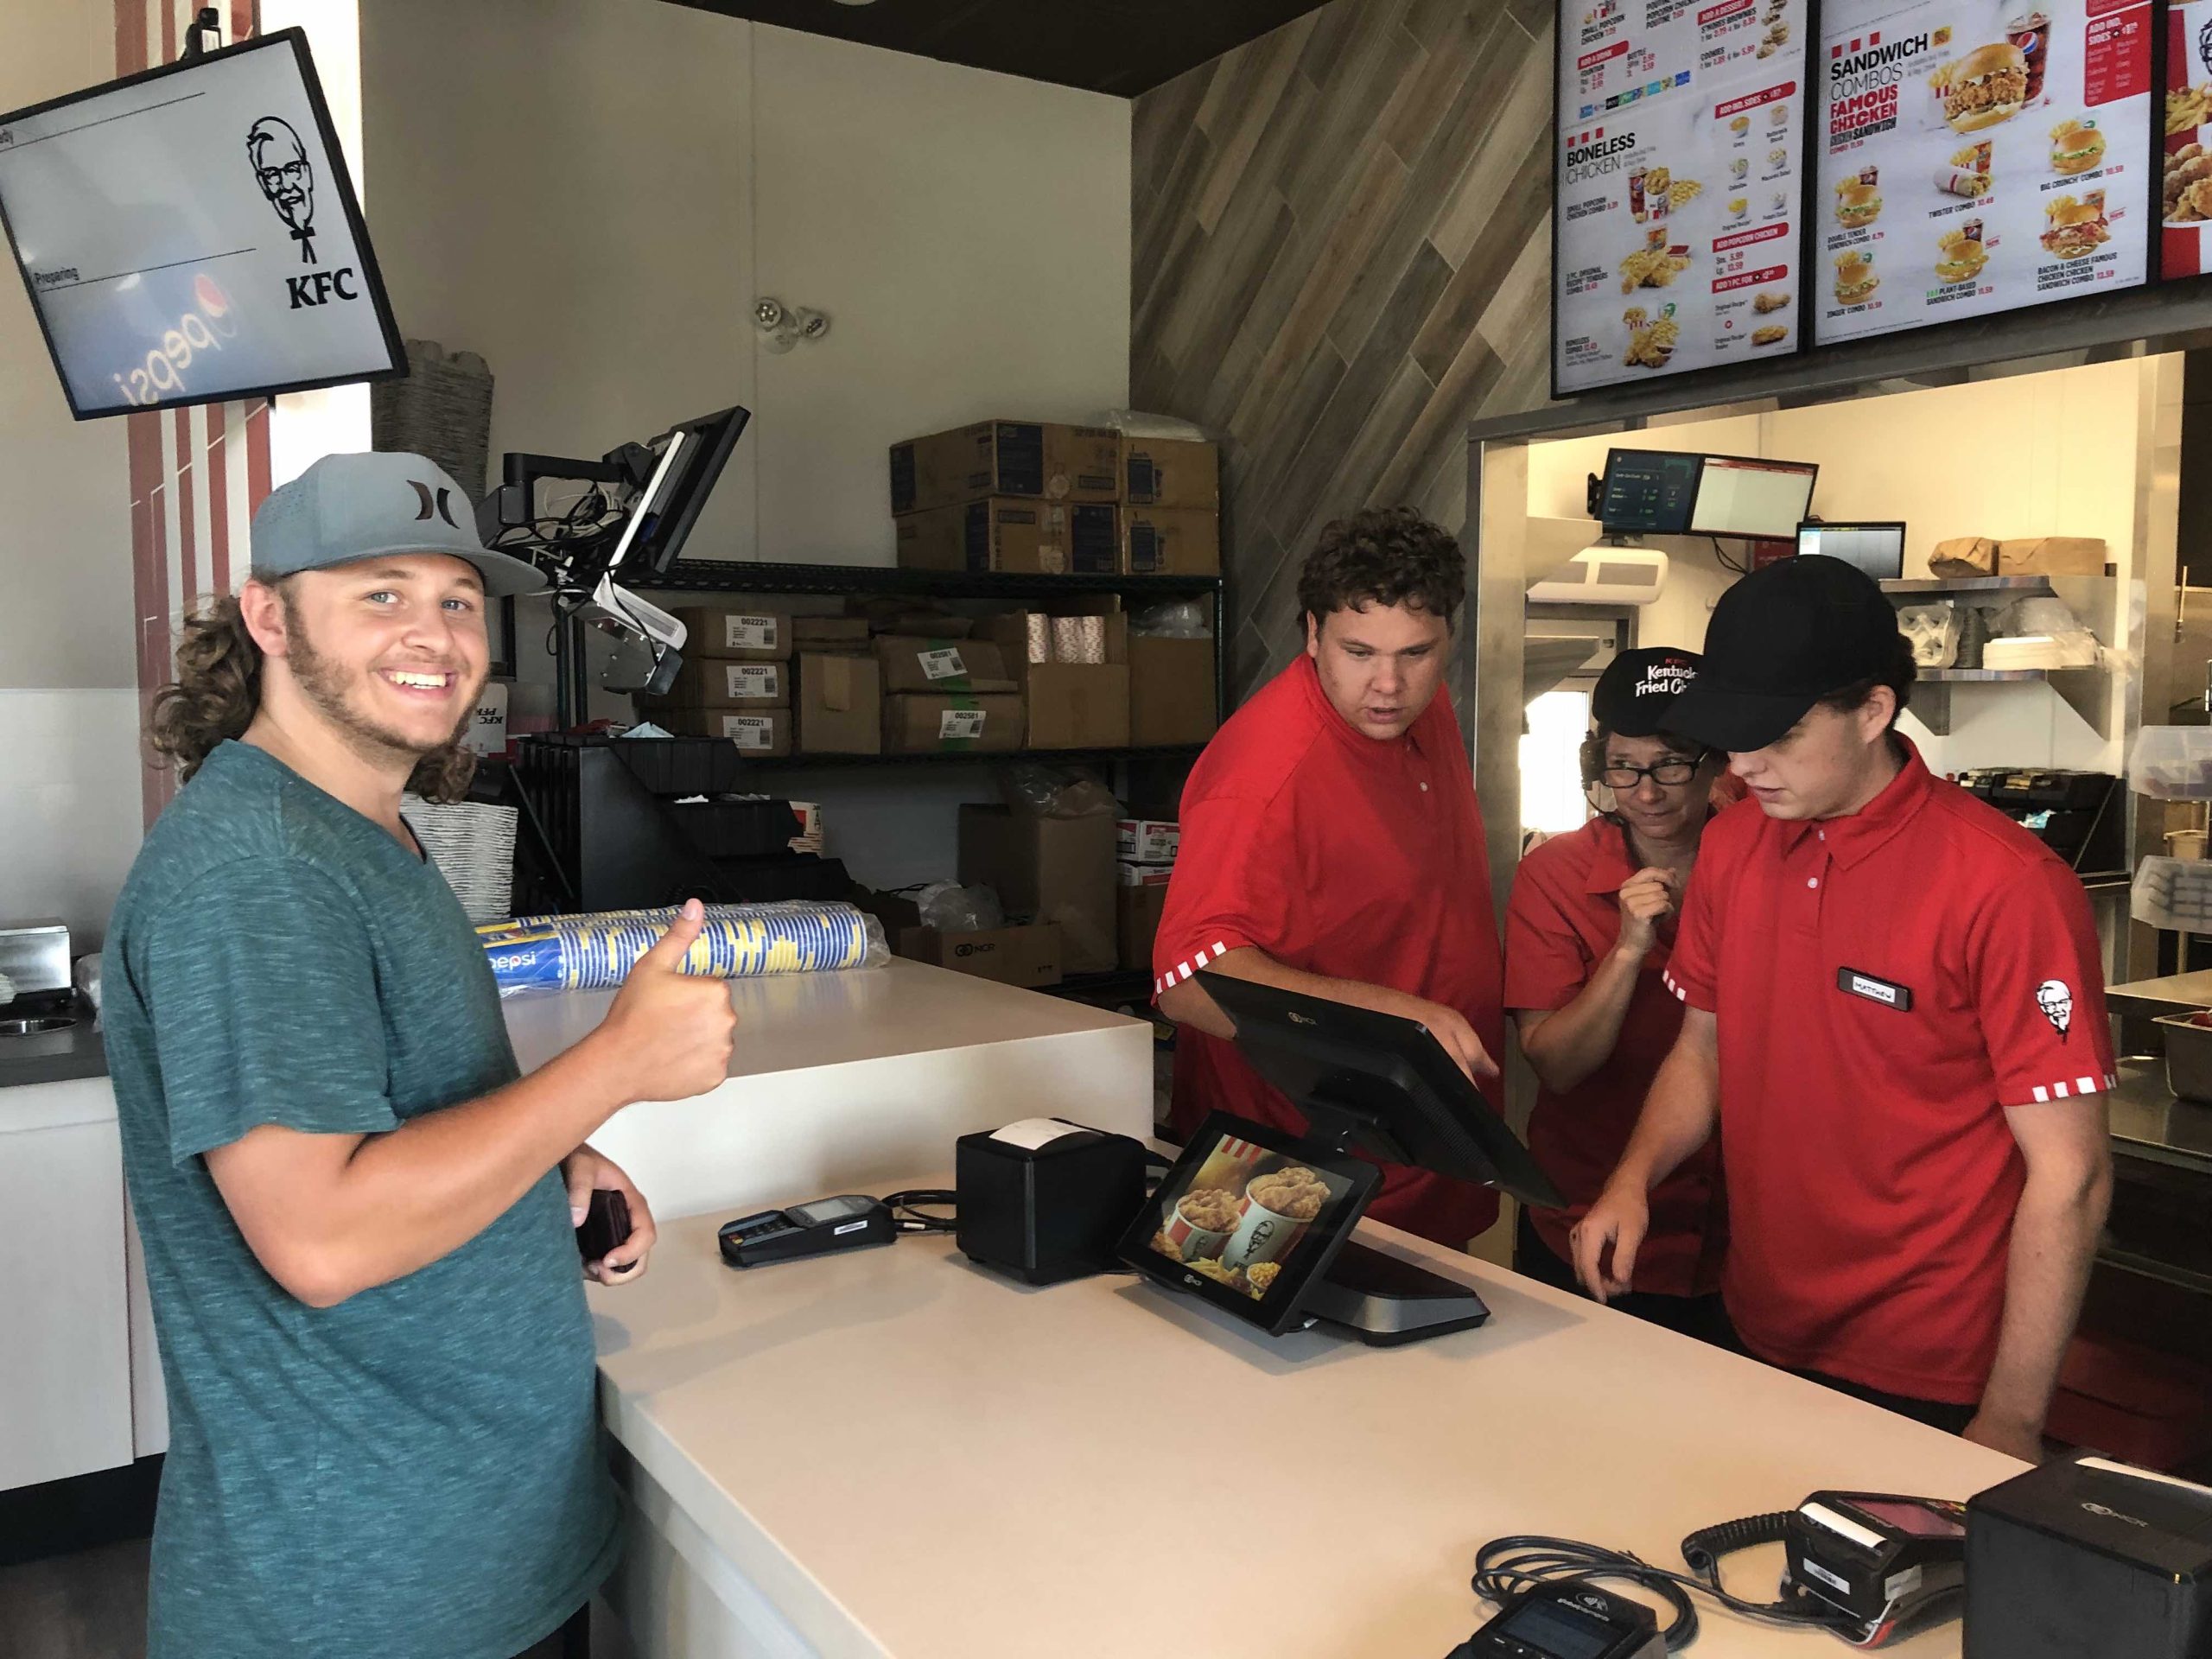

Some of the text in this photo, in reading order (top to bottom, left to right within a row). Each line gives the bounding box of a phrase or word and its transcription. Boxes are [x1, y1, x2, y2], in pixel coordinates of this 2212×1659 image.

[1831, 33, 1928, 80] SANDWICH
[1831, 62, 1903, 100] COMBOS
[1830, 84, 1898, 119] FAMOUS
[1830, 101, 1897, 135] CHICKEN
[1853, 117, 1897, 140] SANDWICH
[1567, 132, 1636, 167] BONELESS
[1567, 154, 1621, 185] CHICKEN
[2040, 181, 2051, 191] BIG
[2081, 170, 2103, 182] COMBO
[1955, 201, 1976, 213] COMBO
[34, 265, 80, 284] Preparing
[2037, 264, 2060, 275] BACON
[2066, 258, 2089, 270] CHEESE
[2091, 252, 2117, 264] FAMOUS
[2037, 266, 2094, 283] CHICKEN CHICKEN
[286, 267, 358, 309] KFC
[2037, 279, 2070, 291] SANDWICH
[2071, 274, 2094, 285] COMBO
[1955, 290, 1976, 301] COMBO
[1647, 665, 1698, 680] Kentuck
[1635, 679, 1668, 697] Fried
[738, 718, 764, 727] 002221
